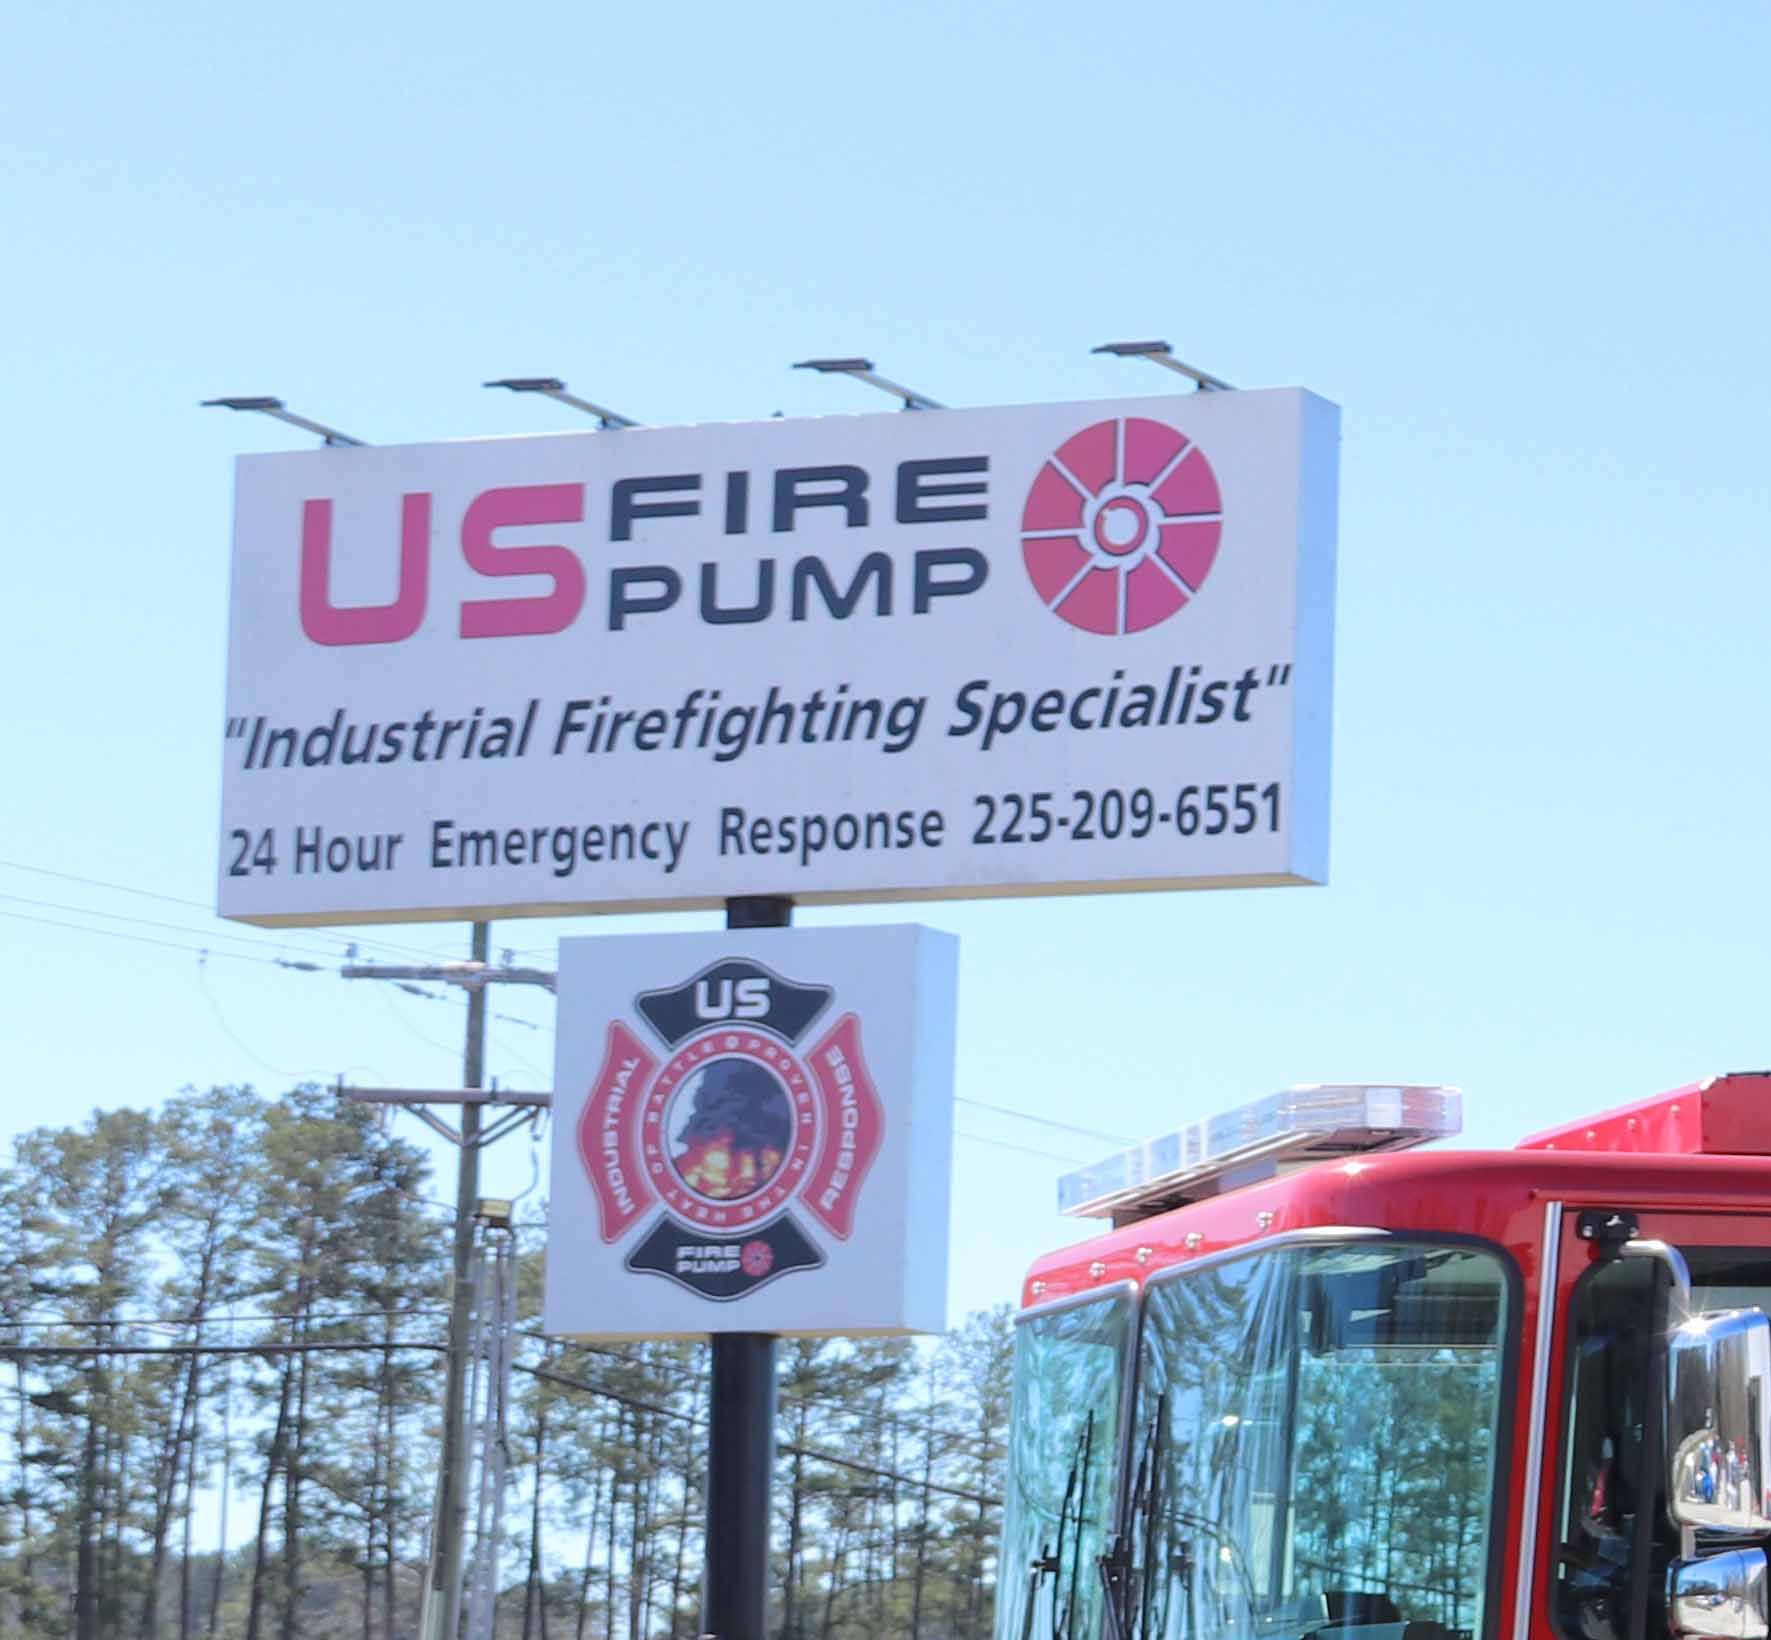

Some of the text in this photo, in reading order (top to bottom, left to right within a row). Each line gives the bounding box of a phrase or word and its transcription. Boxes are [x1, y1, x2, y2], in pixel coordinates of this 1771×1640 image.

[300, 455, 990, 646] US FIRE
[607, 546, 990, 632] PUMP
[225, 663, 1293, 771] "Industrial Firefighting Specialist"
[228, 781, 1281, 879] 24 Hour Emergency Response 225-209-6551
[696, 978, 771, 1020] US
[602, 1057, 642, 1216] INDUSTRIAL
[819, 1046, 861, 1212] RESPONSE
[676, 1246, 742, 1260] FIRE
[676, 1260, 743, 1274] PUMP
